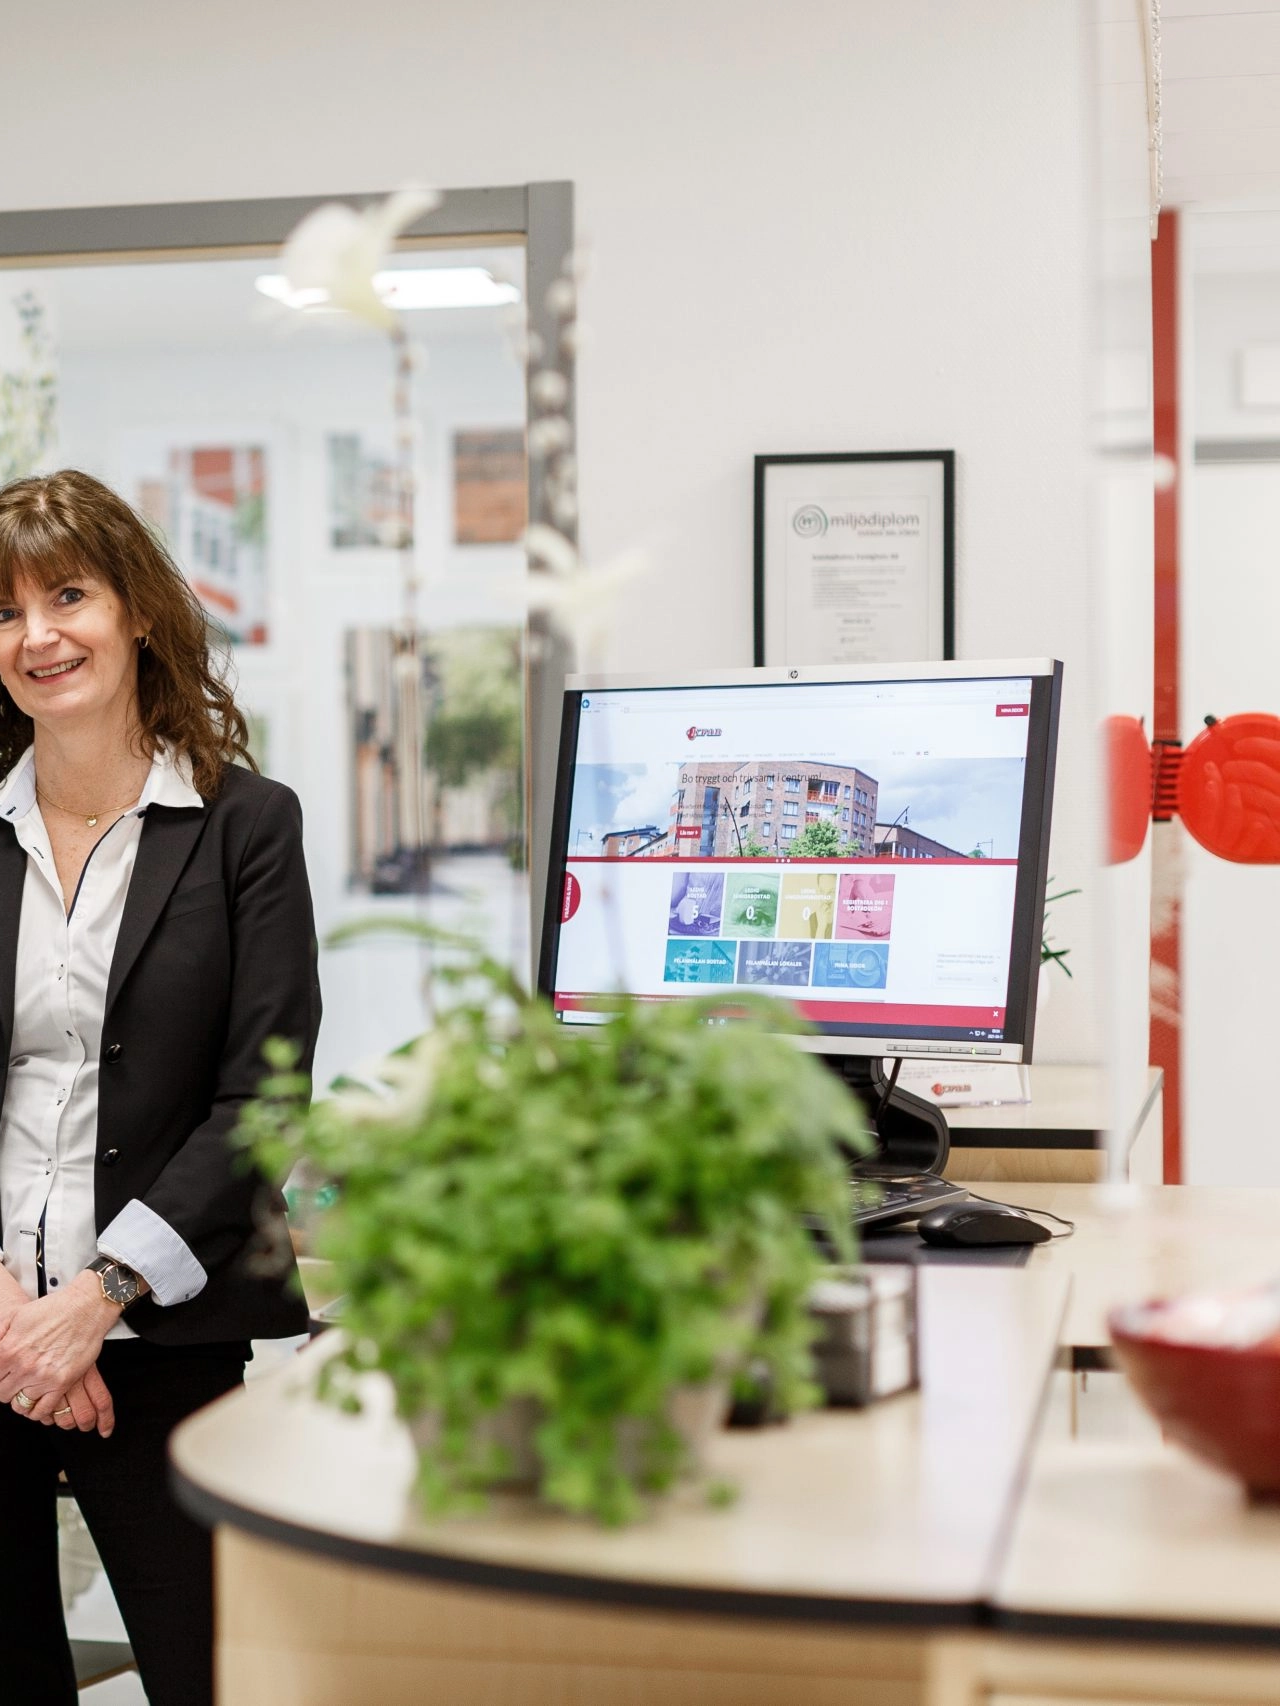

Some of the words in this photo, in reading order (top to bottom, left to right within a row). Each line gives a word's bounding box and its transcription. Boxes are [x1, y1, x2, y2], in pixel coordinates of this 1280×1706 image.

[830, 512, 920, 530] miljödiplom
[682, 773, 694, 784] Bo
[695, 774, 720, 785] tryggt
[723, 773, 737, 783] och
[739, 773, 775, 783] trivsamt
[782, 772, 822, 783] centrum!
[691, 905, 699, 919] 5
[746, 906, 755, 920] 0
[803, 906, 811, 920] 0
